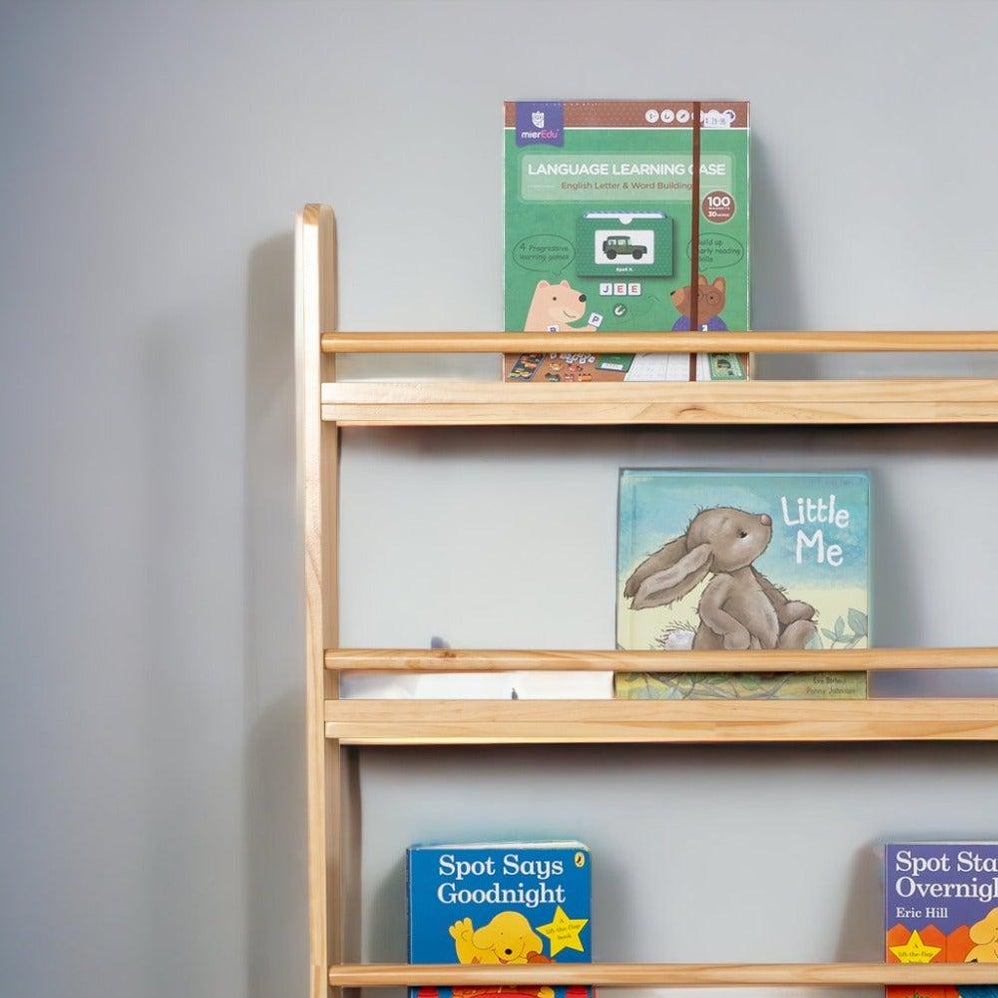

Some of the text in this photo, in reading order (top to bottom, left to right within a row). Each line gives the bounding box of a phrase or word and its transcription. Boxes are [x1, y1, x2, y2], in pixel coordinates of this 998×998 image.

[528, 164, 609, 176] LANGUAGE
[612, 164, 685, 176] LEARNING
[561, 181, 692, 192] English Letter & Word Building
[707, 196, 731, 207] 100
[780, 494, 850, 529] Little
[796, 529, 844, 567] Me
[438, 854, 564, 881] Spot Says
[895, 850, 951, 876] Spot
[437, 882, 566, 908] Goodnight
[896, 907, 948, 918] Eric Hill
